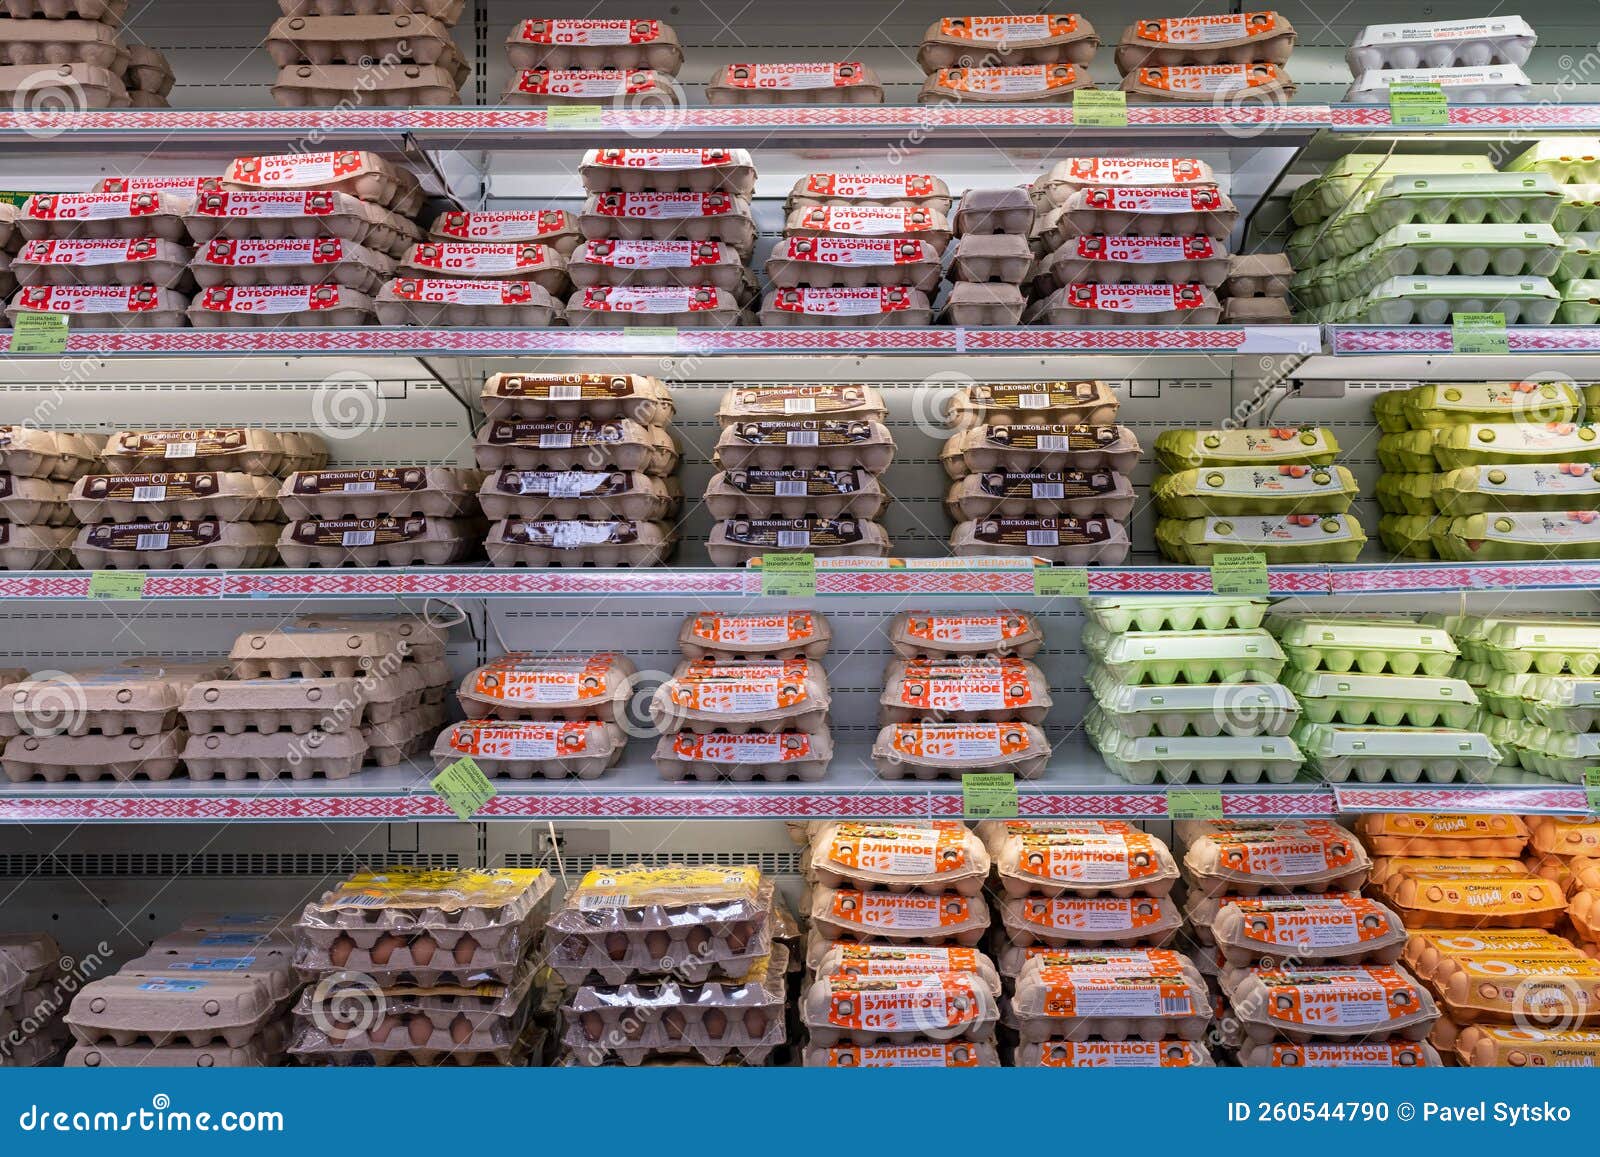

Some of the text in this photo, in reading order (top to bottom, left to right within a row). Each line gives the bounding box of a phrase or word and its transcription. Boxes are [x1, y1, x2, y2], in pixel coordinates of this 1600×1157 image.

[974, 16, 1045, 25] ЭЛИТНОЕ
[1170, 16, 1241, 28] ЭЛИТНОЕ
[557, 22, 627, 30] ОТБОРНОЕ
[759, 66, 831, 74] ОТБОРНОЕ
[972, 67, 1043, 76] ЭЛИТНОЕ
[1172, 66, 1243, 76] ЭЛИТНОЕ
[553, 73, 623, 81] ОТБОРНОЕ
[264, 156, 331, 168] ОТБОРНОЕ
[1102, 160, 1169, 168] ОТБОРНОЕ
[131, 180, 195, 190] ОТБОРНОЕ
[838, 177, 903, 185] ОТБОРНОЕ
[630, 194, 699, 202] ОТБОРНОЕ
[1118, 190, 1188, 198] ОТБОРНОЕ
[61, 195, 129, 204] ОТБОРНОЕ
[231, 195, 303, 203] ОТБОРНОЕ
[473, 214, 536, 223] ОТБОРНОЕ
[834, 211, 902, 220] ОТБОРНОЕ
[59, 241, 126, 250] ОТБОРНОЕ
[240, 243, 310, 251] ОТБОРНОЕ
[821, 242, 891, 251] ОТБОРНОЕ
[447, 247, 514, 255] ОТБОРНОЕ
[427, 282, 499, 290] ОТБОРНОЕ
[55, 288, 127, 298] ОТБОРНОЕ
[237, 290, 307, 298] ОТБОРНОЕ
[808, 291, 878, 299] ОТБОРНОЕ
[831, 560, 883, 568] БЕЛАРУСИ
[723, 619, 785, 627] ЭЛИТНОЕ
[936, 617, 998, 626] ЭЛИТНОЕ
[507, 675, 575, 684] ЭЛИТНОЕ
[933, 685, 1000, 693] ЭЛИТНОЕ
[484, 731, 554, 740] ЭЛИТНОЕ
[707, 735, 777, 744] ЭЛИТНОЕ
[926, 731, 996, 740] ЭЛИТНОЕ
[863, 844, 933, 855] ЭЛИТНОЕ
[1252, 844, 1321, 855] ЭЛИТНОЕ
[1054, 852, 1125, 862] ЭЛИТНОЕ
[866, 898, 937, 909] ЭЛИТНОЕ
[1056, 901, 1128, 911] ЭЛИТНОЕ
[1278, 916, 1352, 926] ЭЛИТНОЕ
[1304, 992, 1383, 1004] ЭЛИТНОЕ
[864, 1000, 942, 1010] ЭЛИТНОЕ
[865, 1015, 881, 1027] С1
[864, 1047, 942, 1059] ЭЛИТНОЕ
[1077, 1044, 1156, 1054] ЭЛИТНОЕ
[1308, 1051, 1388, 1061] ЭЛИТНОЕ
